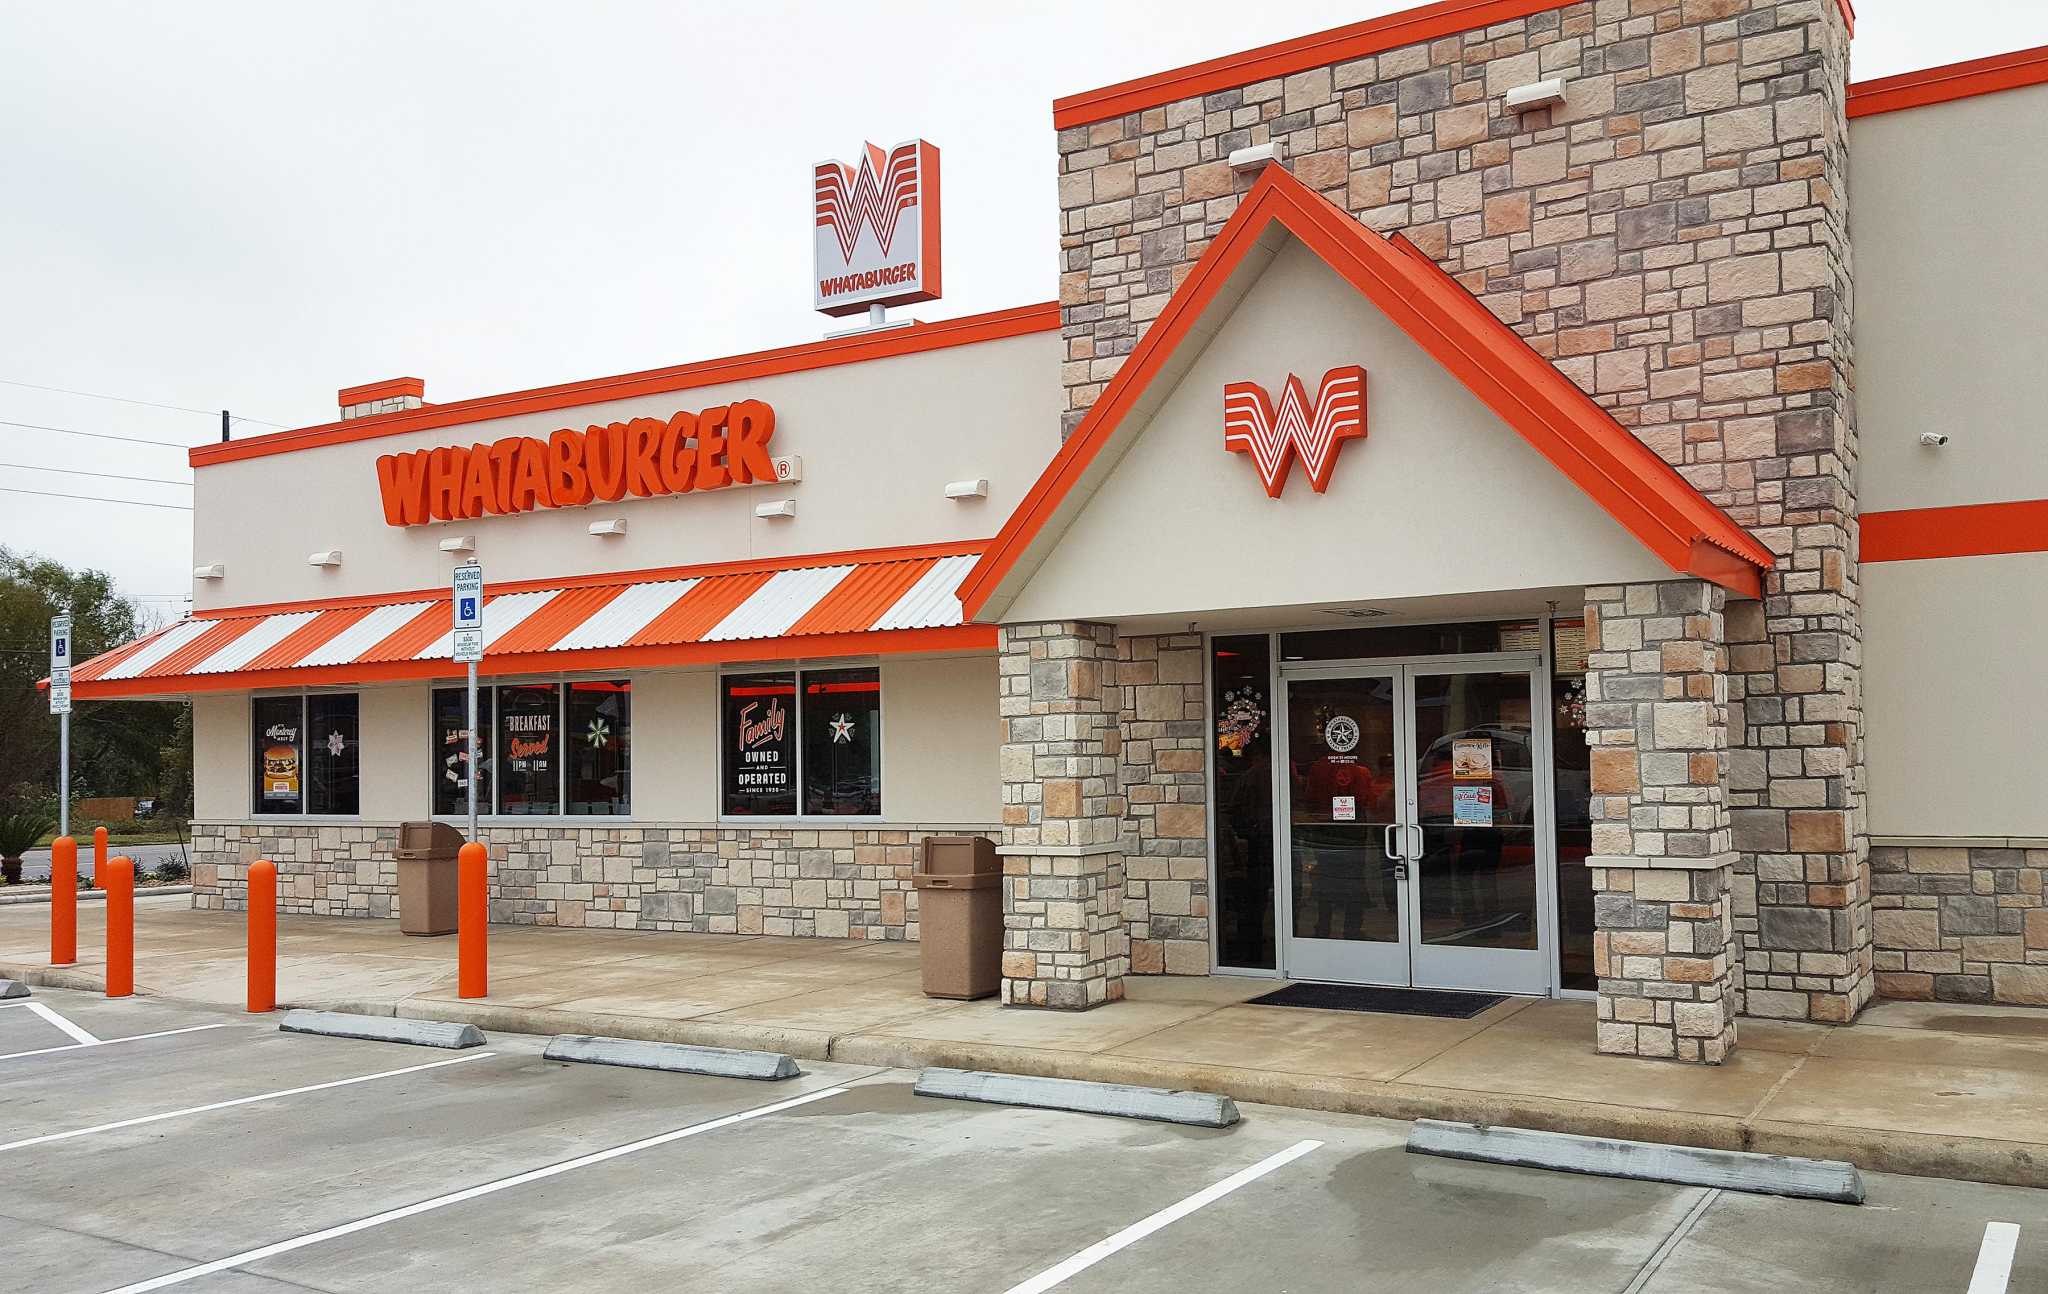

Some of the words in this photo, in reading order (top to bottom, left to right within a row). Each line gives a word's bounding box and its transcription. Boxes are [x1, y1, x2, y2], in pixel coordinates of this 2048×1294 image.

[819, 262, 917, 298] WHATABURGER
[375, 398, 779, 528] WHATABURGER
[455, 571, 480, 580] RESERVED
[456, 582, 479, 592] PARKING
[509, 715, 551, 731] BREAKFAST
[738, 697, 785, 752] Family
[745, 751, 779, 763] OWNED
[738, 772, 787, 785] OPERATED
